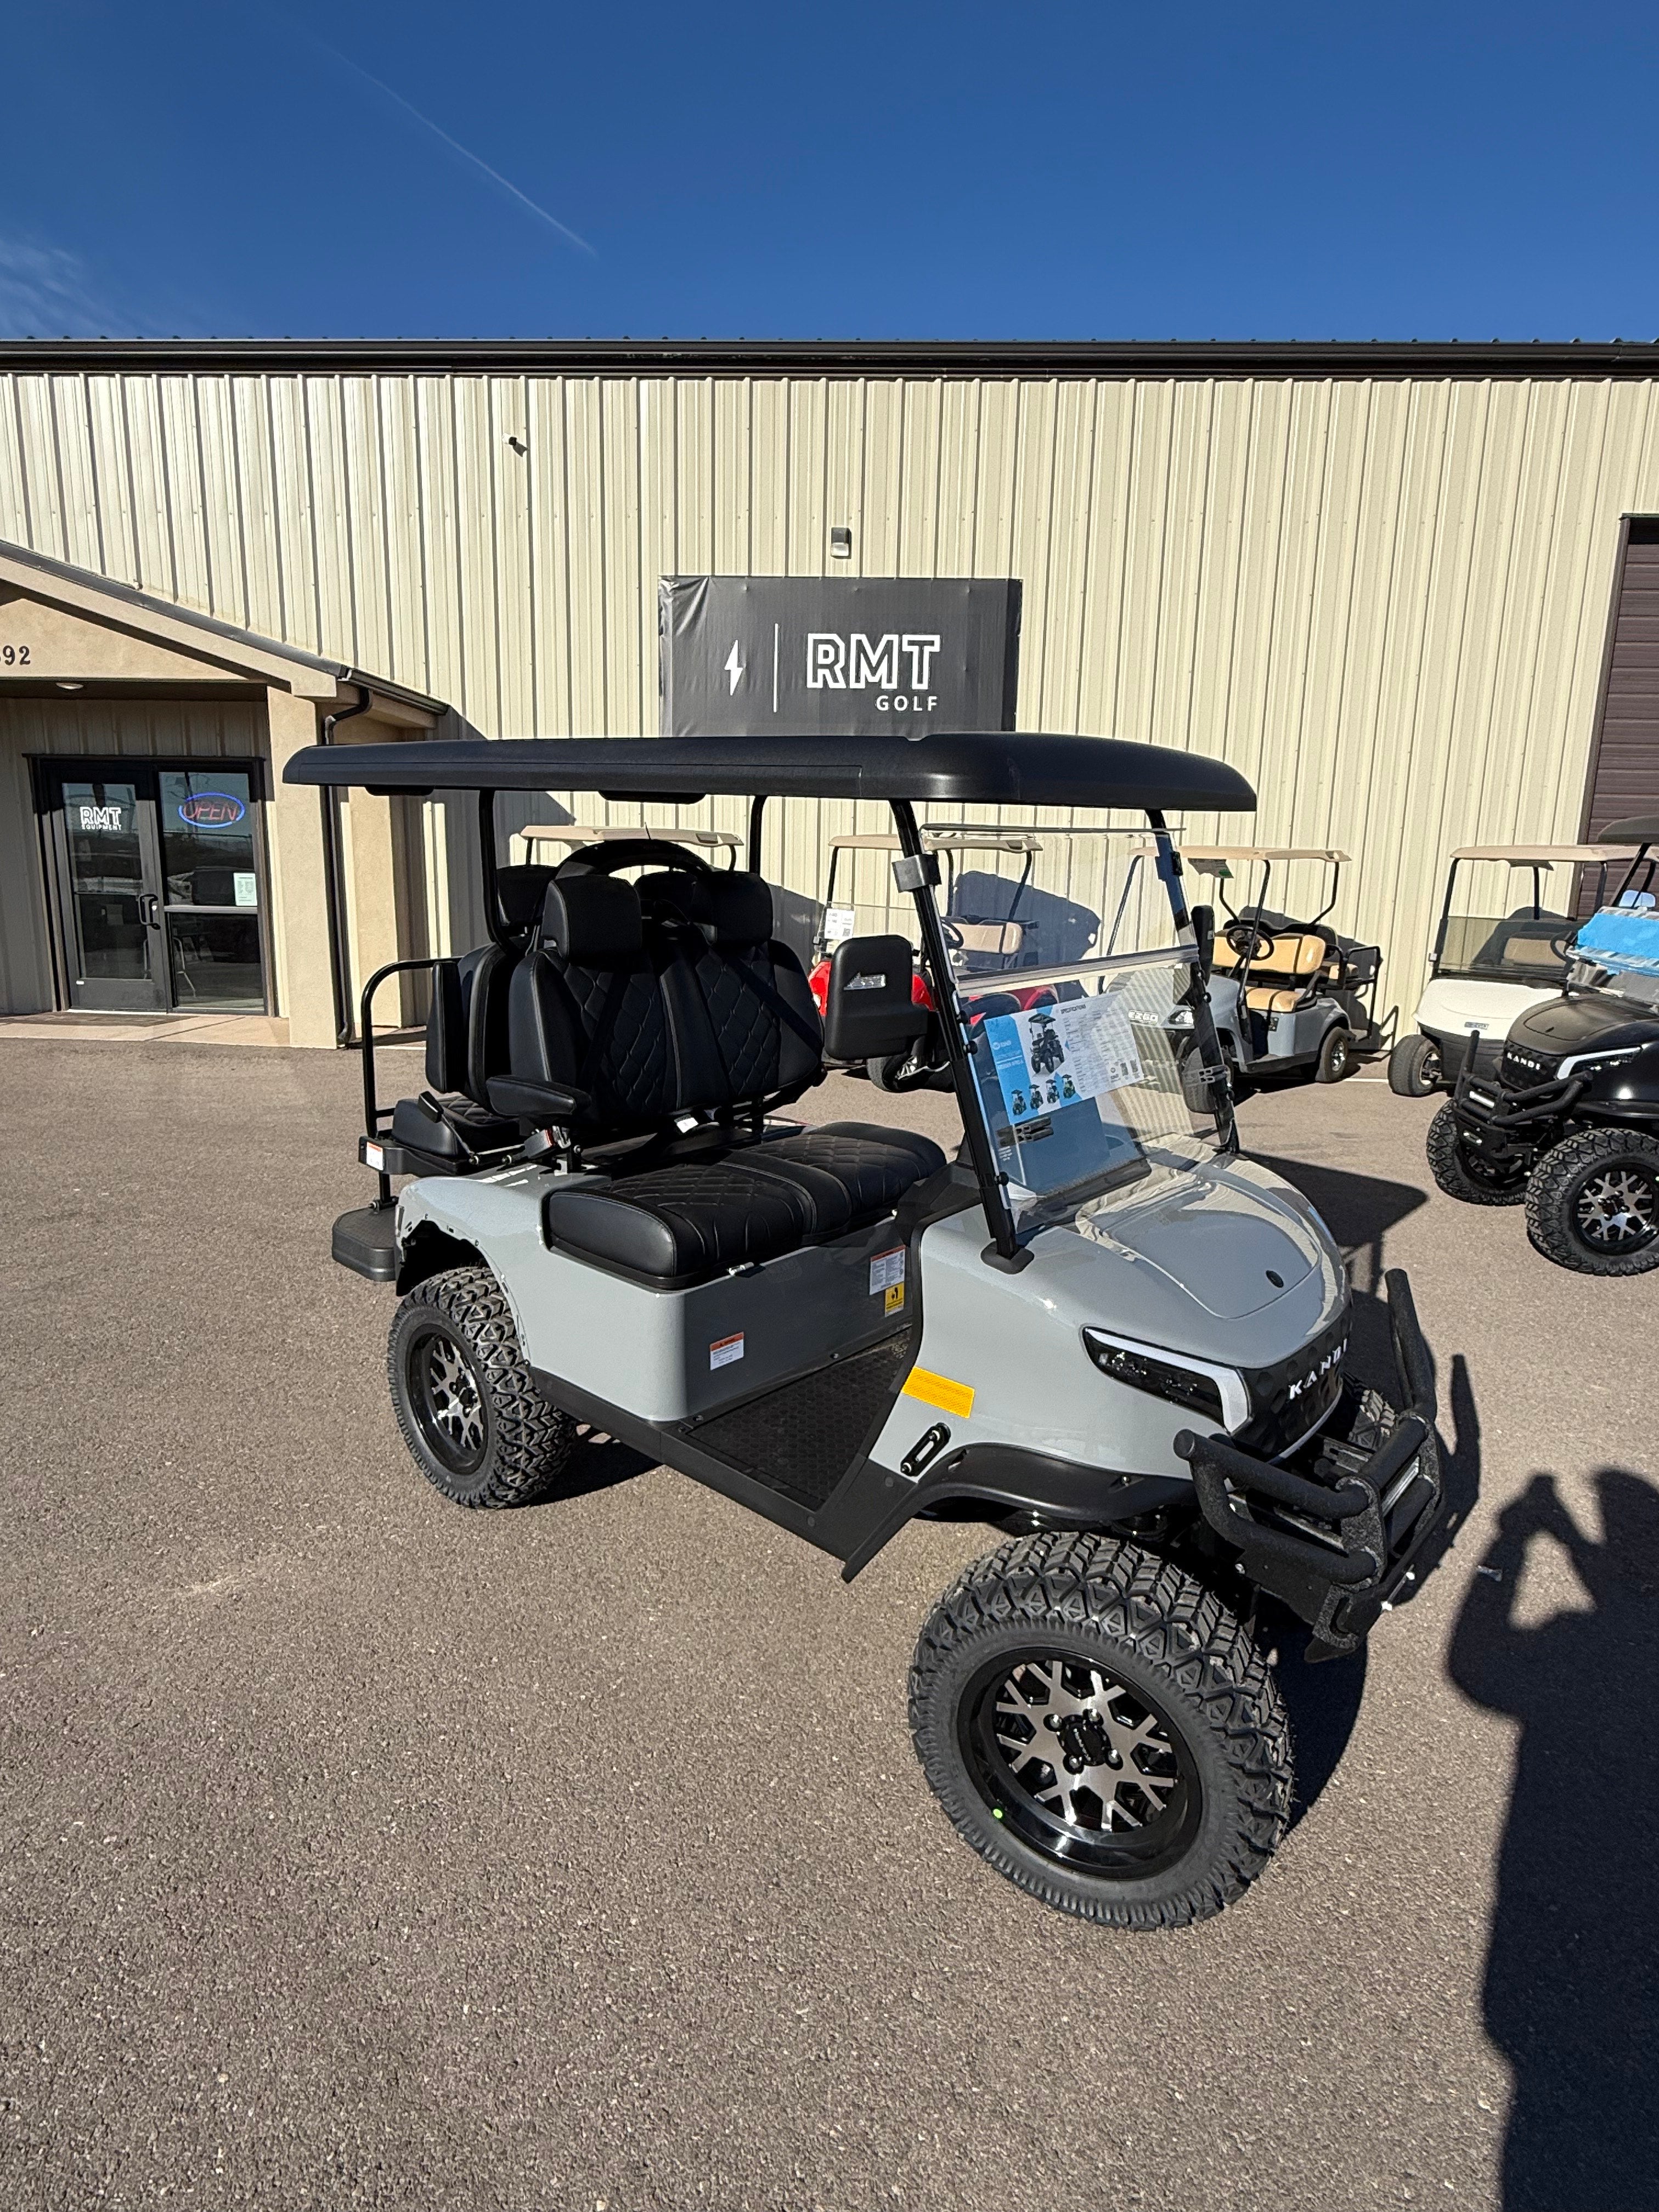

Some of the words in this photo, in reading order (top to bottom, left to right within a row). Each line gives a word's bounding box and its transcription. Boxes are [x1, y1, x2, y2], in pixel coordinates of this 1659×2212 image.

[0, 645, 31, 665] 92
[807, 634, 940, 690] RMT
[876, 695, 937, 712] GOLF
[80, 806, 122, 825] RMT
[1506, 1051, 1541, 1071] KANDI
[1288, 1338, 1347, 1400] KANDI
